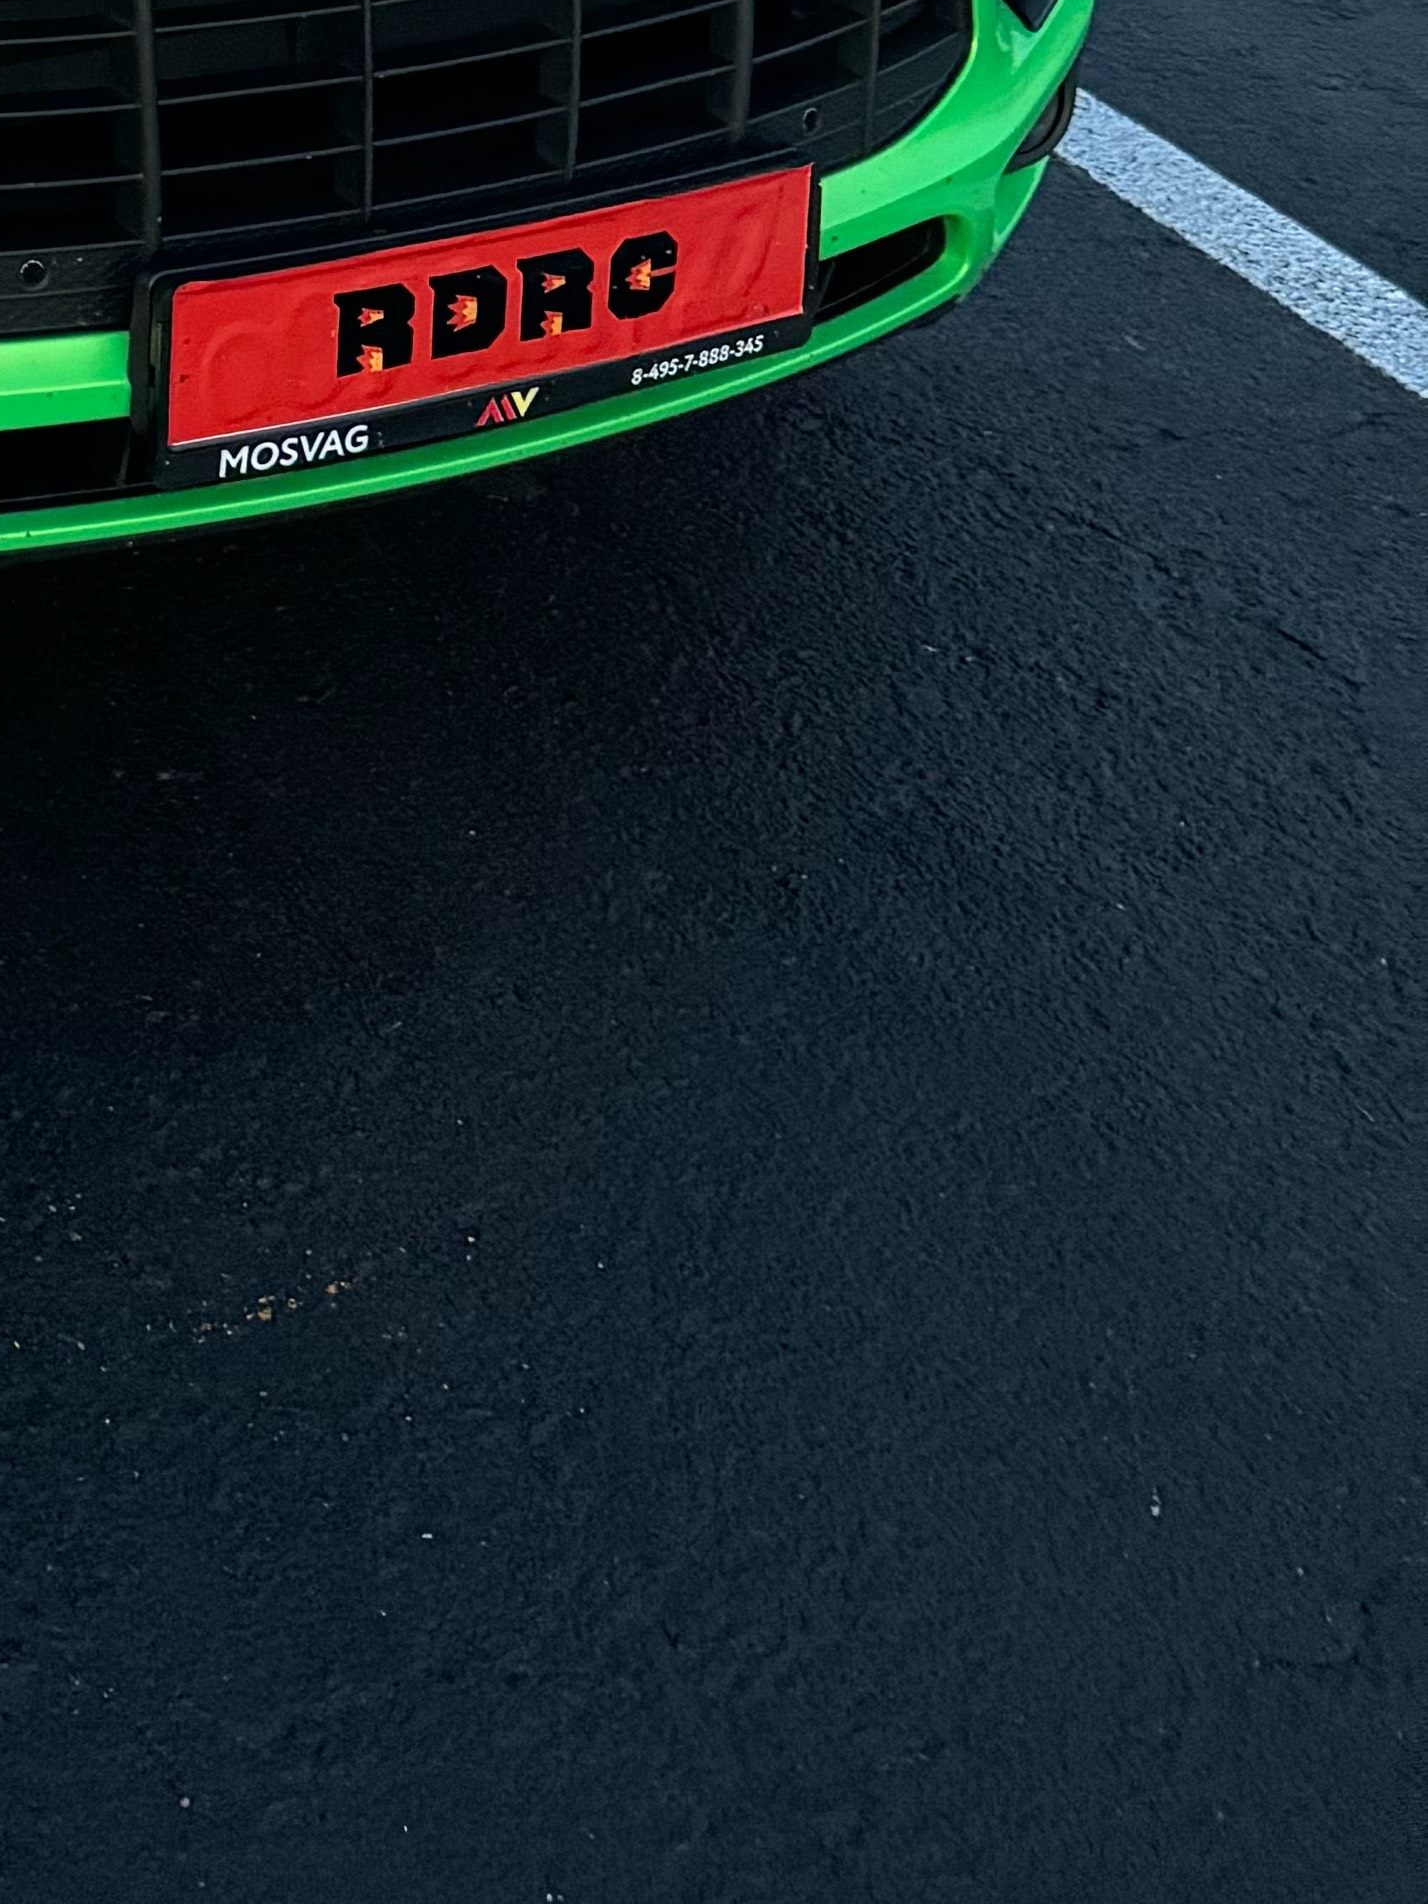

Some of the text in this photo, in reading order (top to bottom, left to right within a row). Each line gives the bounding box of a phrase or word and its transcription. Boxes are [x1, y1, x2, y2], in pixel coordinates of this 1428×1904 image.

[333, 230, 679, 379] RDRC
[218, 424, 370, 479] MOSVAG
[630, 334, 765, 386] 8-495-7-888-345
